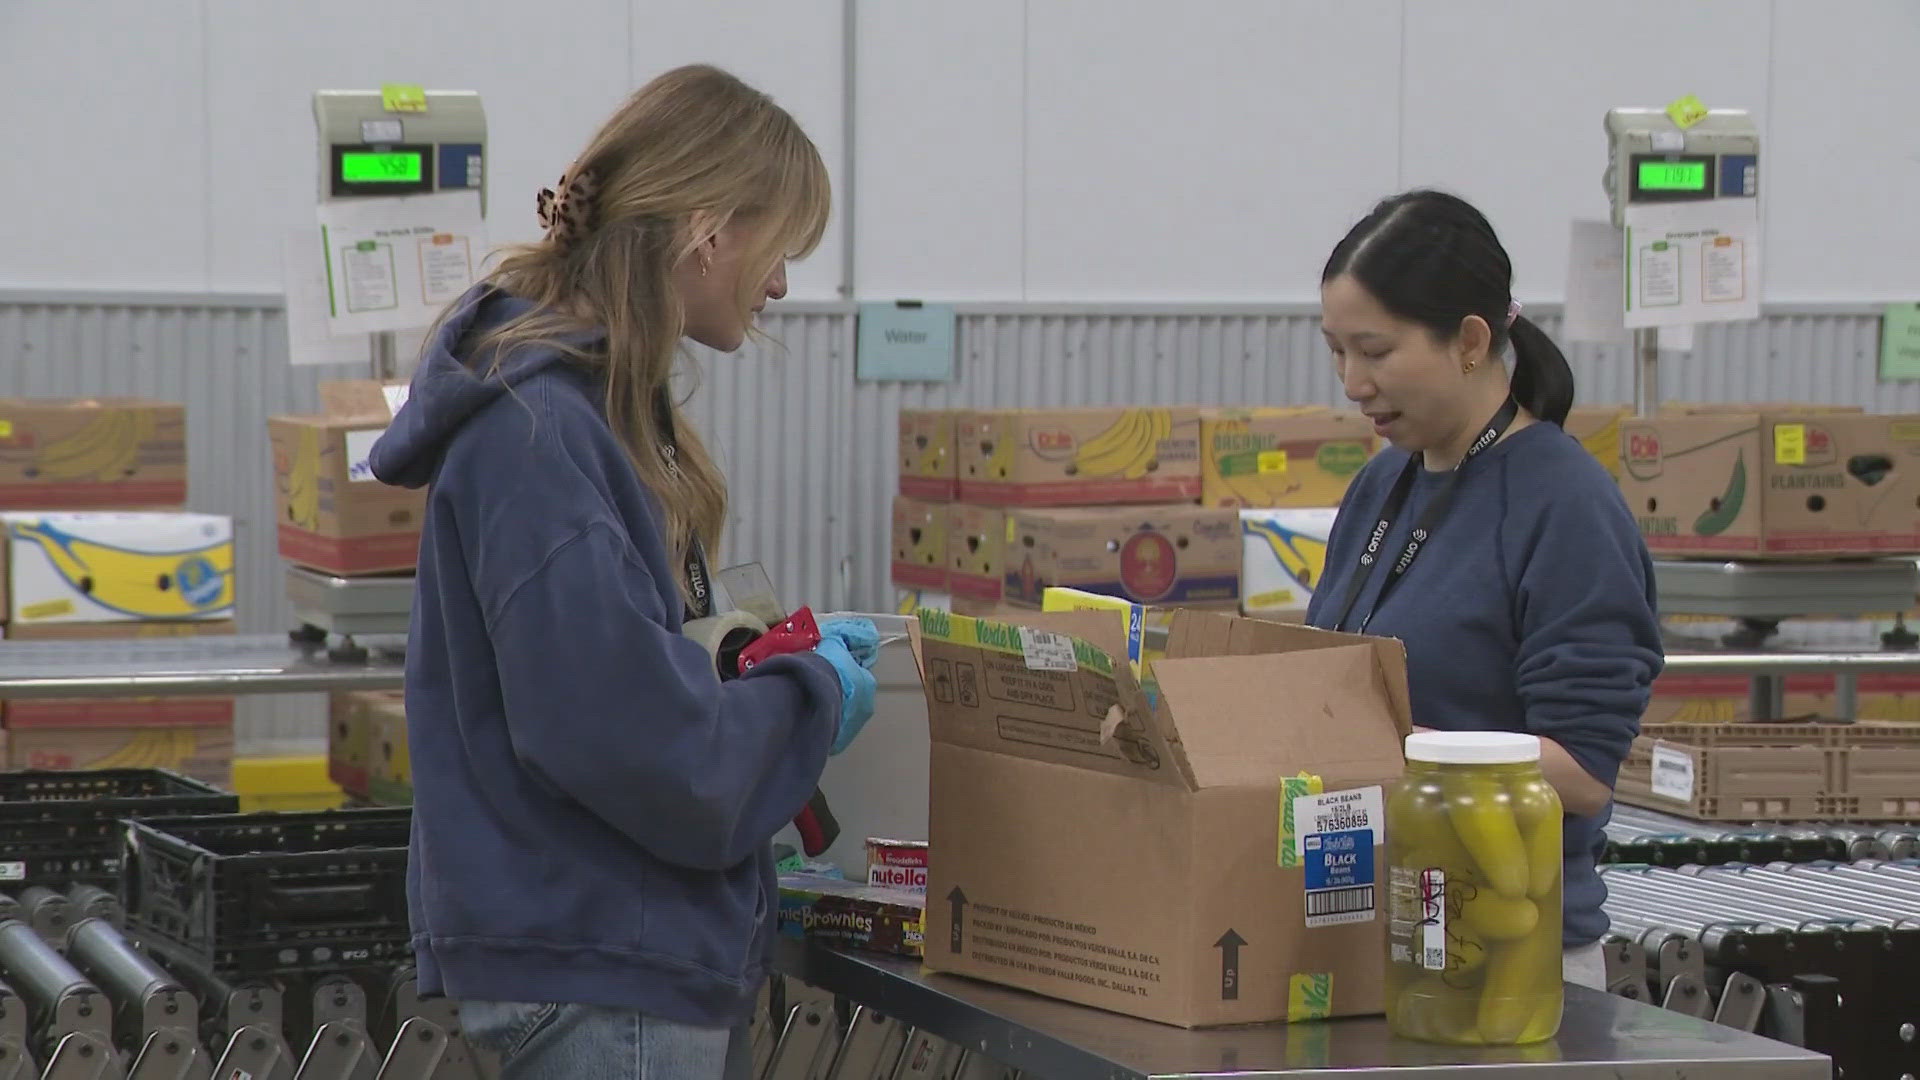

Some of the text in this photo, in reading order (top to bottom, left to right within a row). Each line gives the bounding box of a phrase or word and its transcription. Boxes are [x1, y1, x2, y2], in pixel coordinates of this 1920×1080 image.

[885, 329, 928, 344] Water
[1039, 431, 1072, 449] Dole
[1214, 433, 1276, 451] ORGANIC
[1468, 427, 1497, 456] ontra
[1630, 434, 1659, 457] Dole
[1771, 472, 1844, 490] PLANTAINS
[1367, 519, 1389, 553] ontra
[921, 608, 951, 638] Valle
[976, 619, 1007, 648] Verde
[1317, 793, 1362, 806] BLACK BEANS
[1317, 814, 1368, 832] 576360859
[1324, 853, 1357, 866] BLACK
[872, 868, 926, 886] nutella
[801, 905, 874, 933] Brownies
[1034, 915, 1065, 928] PRODUCTO
[1087, 943, 1106, 954] VERDE
[972, 951, 1008, 966] DISTRIBUTED
[1038, 965, 1056, 976] VERDE
[1088, 959, 1108, 972] VERDE
